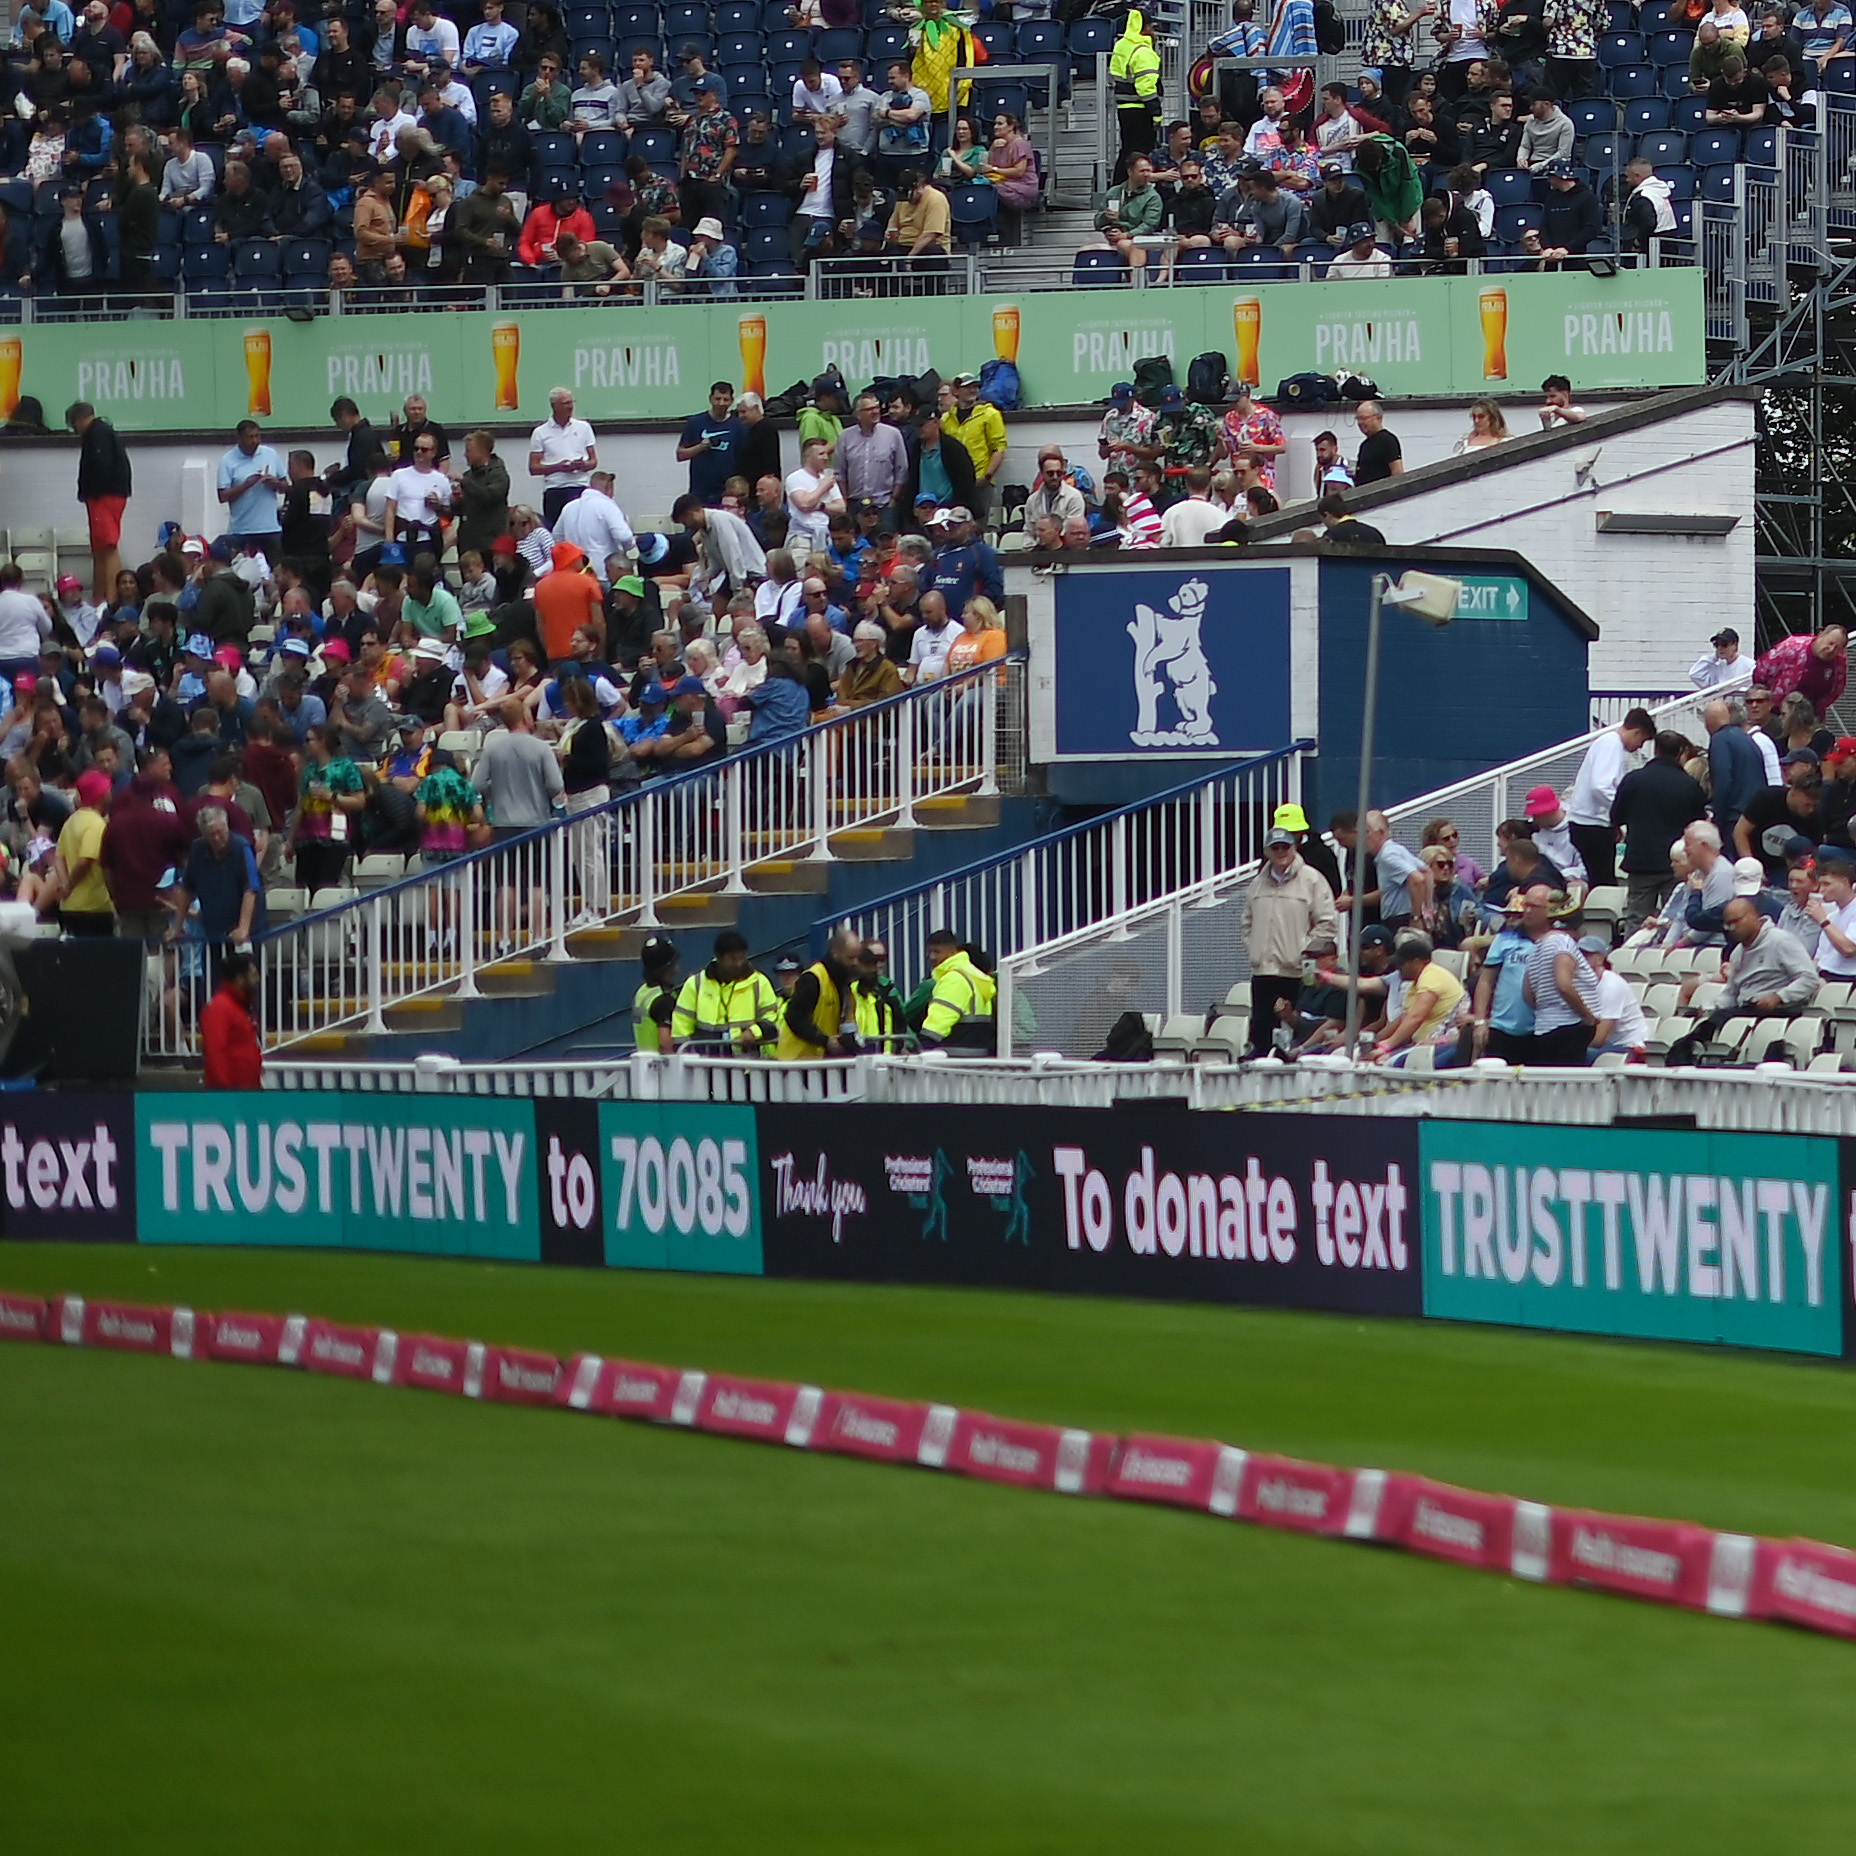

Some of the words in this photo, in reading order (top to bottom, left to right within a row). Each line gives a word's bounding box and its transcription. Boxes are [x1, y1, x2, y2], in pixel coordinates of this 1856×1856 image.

[1073, 330, 1176, 373] PRAVHA
[1315, 320, 1421, 365] PRAVHA
[1564, 310, 1674, 356] PRAVHA
[78, 359, 185, 401] PRAVHA
[327, 352, 433, 395] PRAVHA
[574, 345, 680, 388] PRAVHA
[822, 338, 931, 380] PRAVHA
[1458, 586, 1498, 609] EXIT
[1, 1125, 117, 1209] text
[150, 1121, 525, 1225] TRUSTTWENTY
[547, 1136, 595, 1229] to
[611, 1136, 750, 1237] 70085
[771, 1152, 829, 1219] Thank
[831, 1179, 866, 1243] you
[1053, 1147, 1112, 1252] To
[1125, 1146, 1297, 1263] donate
[1312, 1160, 1407, 1271] text
[1430, 1161, 1829, 1307] TRUSTTWENTY
